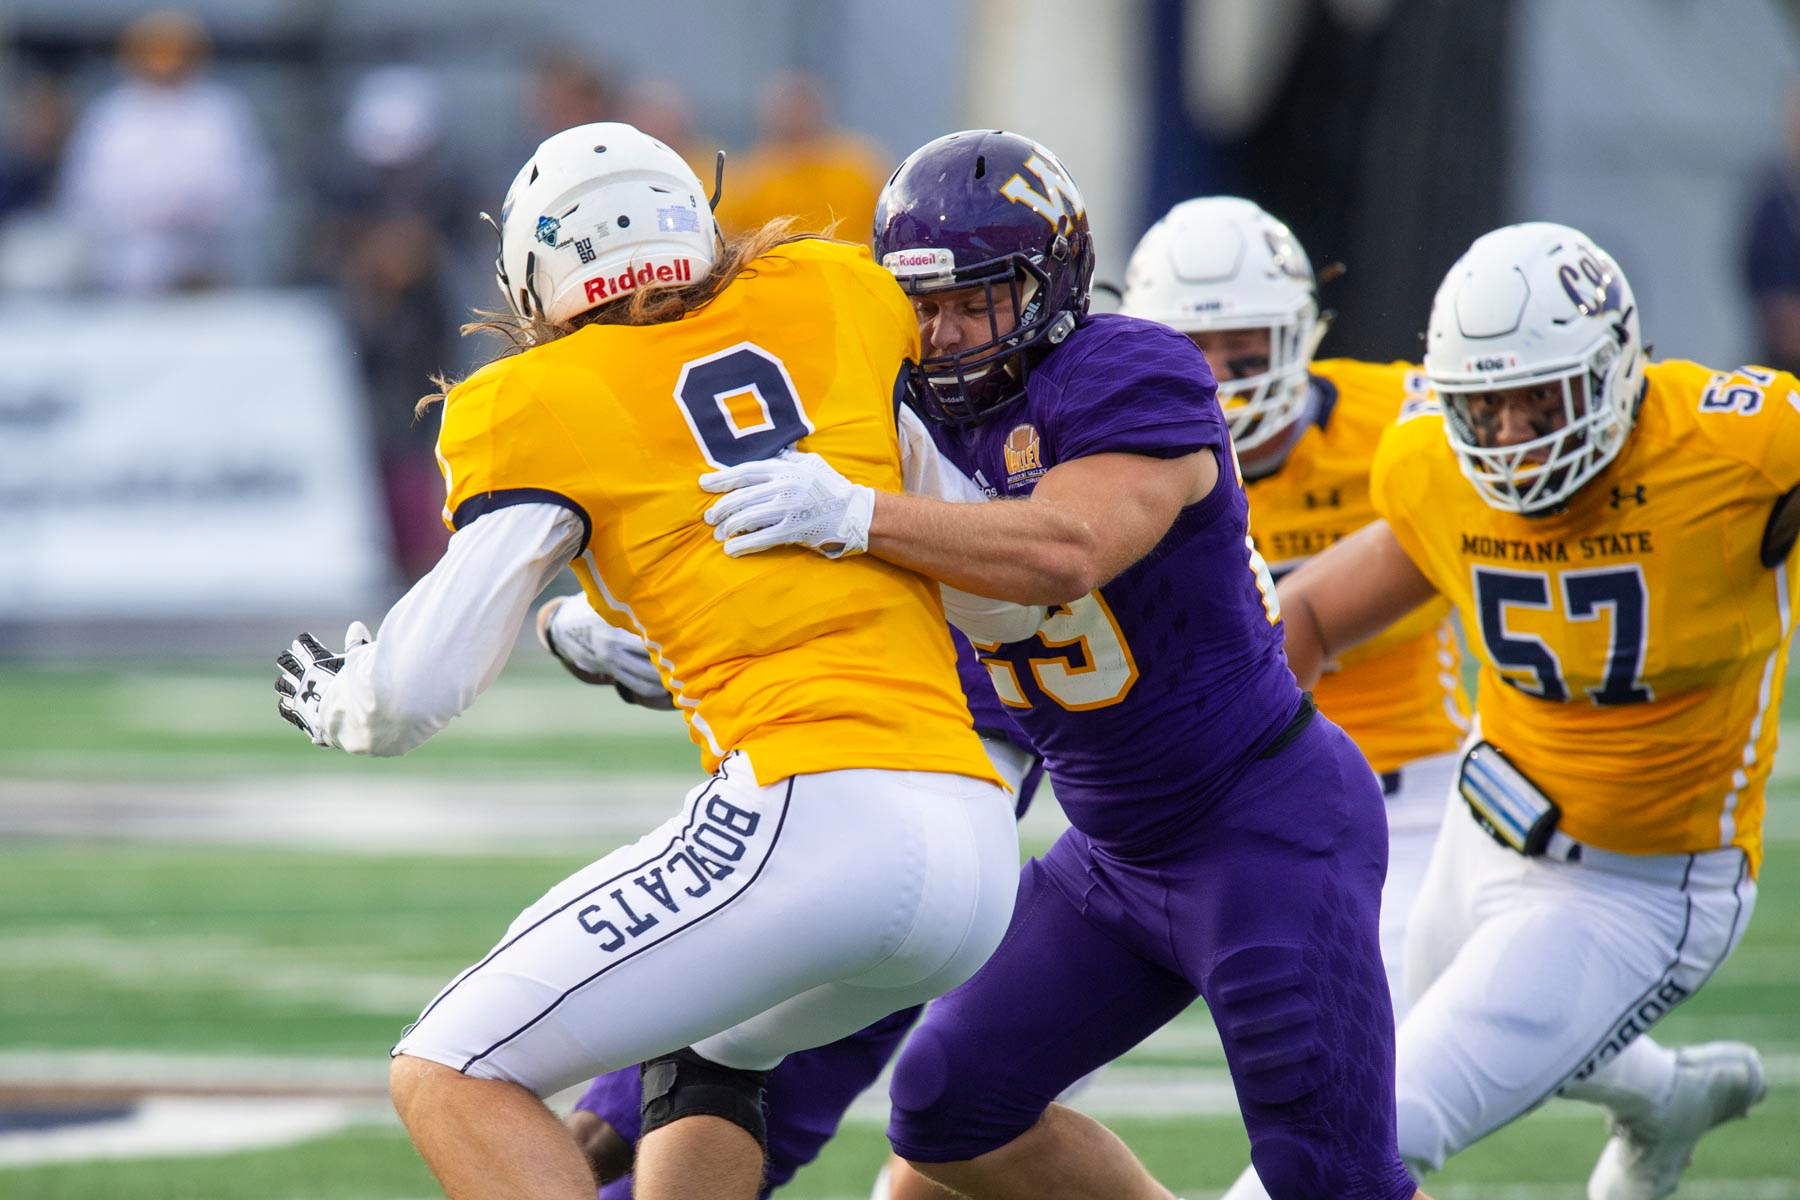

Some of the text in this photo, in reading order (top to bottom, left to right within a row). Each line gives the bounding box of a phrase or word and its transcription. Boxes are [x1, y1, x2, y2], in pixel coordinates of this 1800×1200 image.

[1000, 143, 1085, 237] W
[584, 258, 690, 304] Riddell
[899, 252, 936, 266] Riddell
[1004, 437, 1042, 475] VALLEY
[1462, 531, 1654, 563] MONTANA STATE
[969, 587, 1140, 712] 9
[1471, 562, 1655, 707] 57
